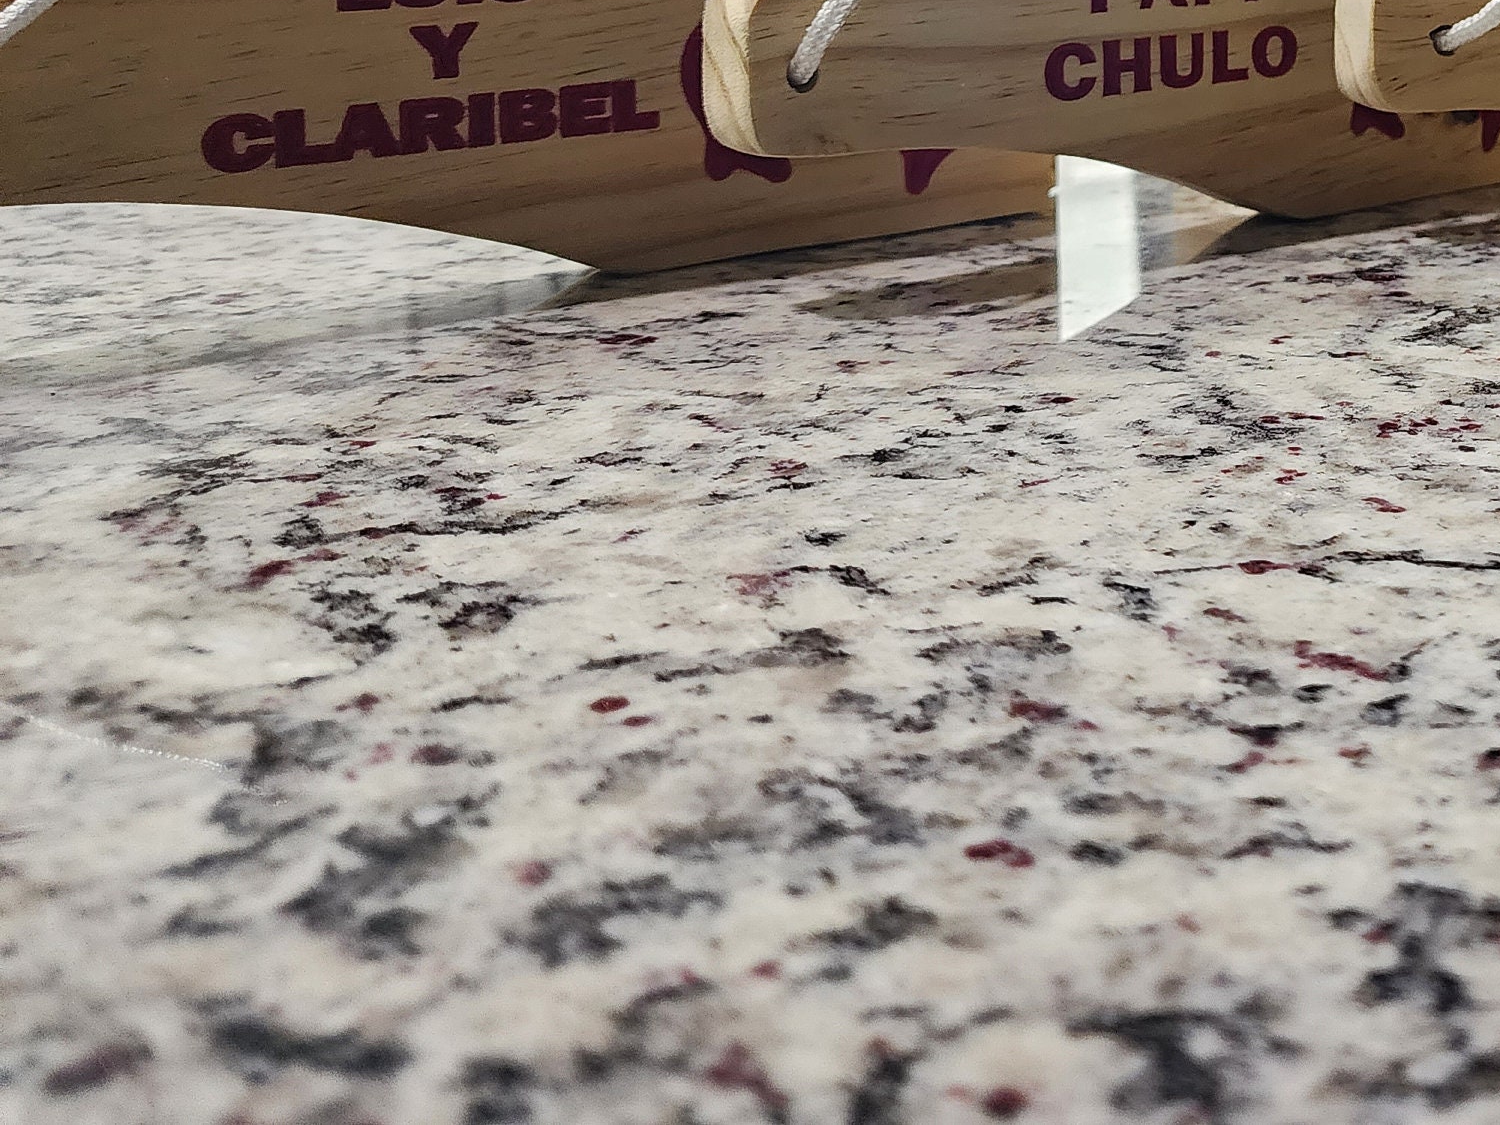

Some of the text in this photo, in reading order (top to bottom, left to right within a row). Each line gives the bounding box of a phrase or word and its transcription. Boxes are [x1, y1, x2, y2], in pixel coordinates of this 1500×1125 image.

[409, 20, 480, 79] Y
[1043, 25, 1299, 102] CHULO
[200, 78, 661, 174] CLARIBEL
